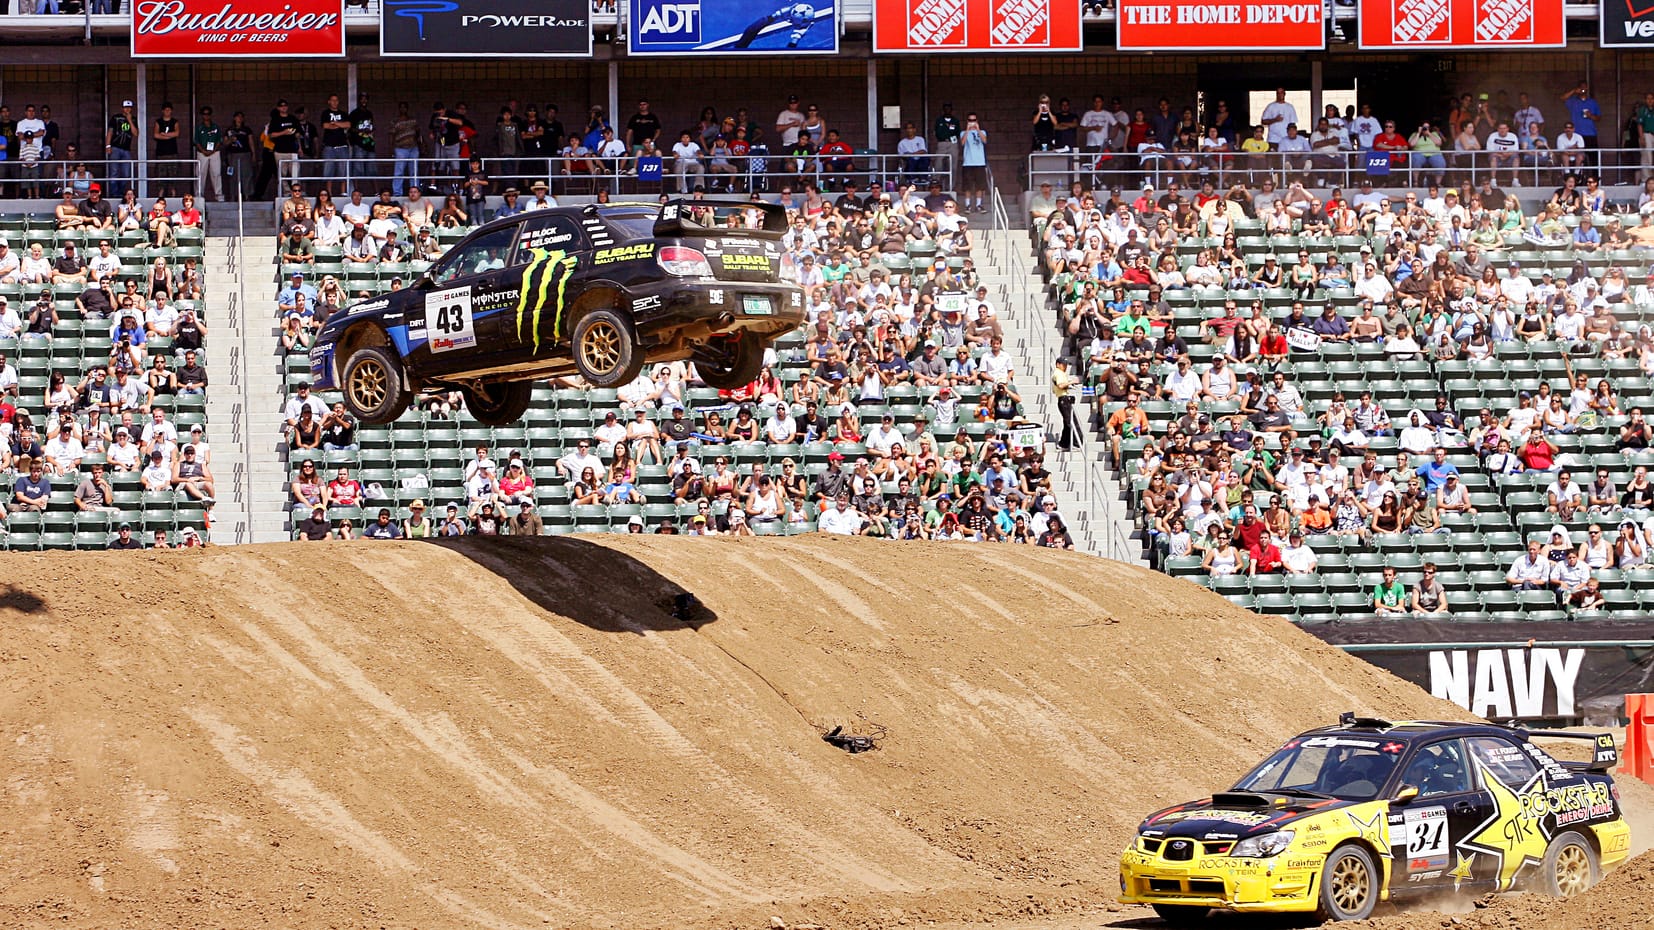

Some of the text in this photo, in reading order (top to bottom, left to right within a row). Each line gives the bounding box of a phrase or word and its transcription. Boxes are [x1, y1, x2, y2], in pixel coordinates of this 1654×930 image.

[138, 1, 337, 35] Budweiser
[462, 15, 585, 27] POWERADE
[640, 4, 700, 33] ADT
[1124, 4, 1319, 24] THE HOME DEPOT
[1394, 0, 1448, 41] HOM
[1477, 0, 1530, 40] HOM
[1497, 4, 1531, 40] DEPOT
[930, 9, 965, 45] DEPOT
[1013, 9, 1048, 44] DEPOT
[1415, 5, 1449, 41] DEPOT
[198, 33, 287, 42] KING OF BEERS
[642, 164, 658, 172] 131
[1369, 158, 1387, 166] 132
[530, 233, 572, 248] GELSOMINO
[532, 227, 557, 239] BLOCK
[595, 243, 655, 260] SUBARU
[595, 257, 616, 265] RALLY
[617, 254, 636, 262] TEAM
[721, 254, 770, 266] SUBARU
[450, 290, 470, 299] GAMES
[472, 289, 520, 306] MONSTER
[632, 295, 661, 309] SPT
[480, 301, 514, 311] ENERGY
[945, 299, 960, 310] 43
[436, 304, 464, 334] 43
[1020, 434, 1035, 446] 43
[1429, 648, 1586, 718] NAVY
[1557, 803, 1612, 826] ENERGY DRINK
[1409, 820, 1445, 853] 34
[1288, 859, 1322, 867] Crawford
